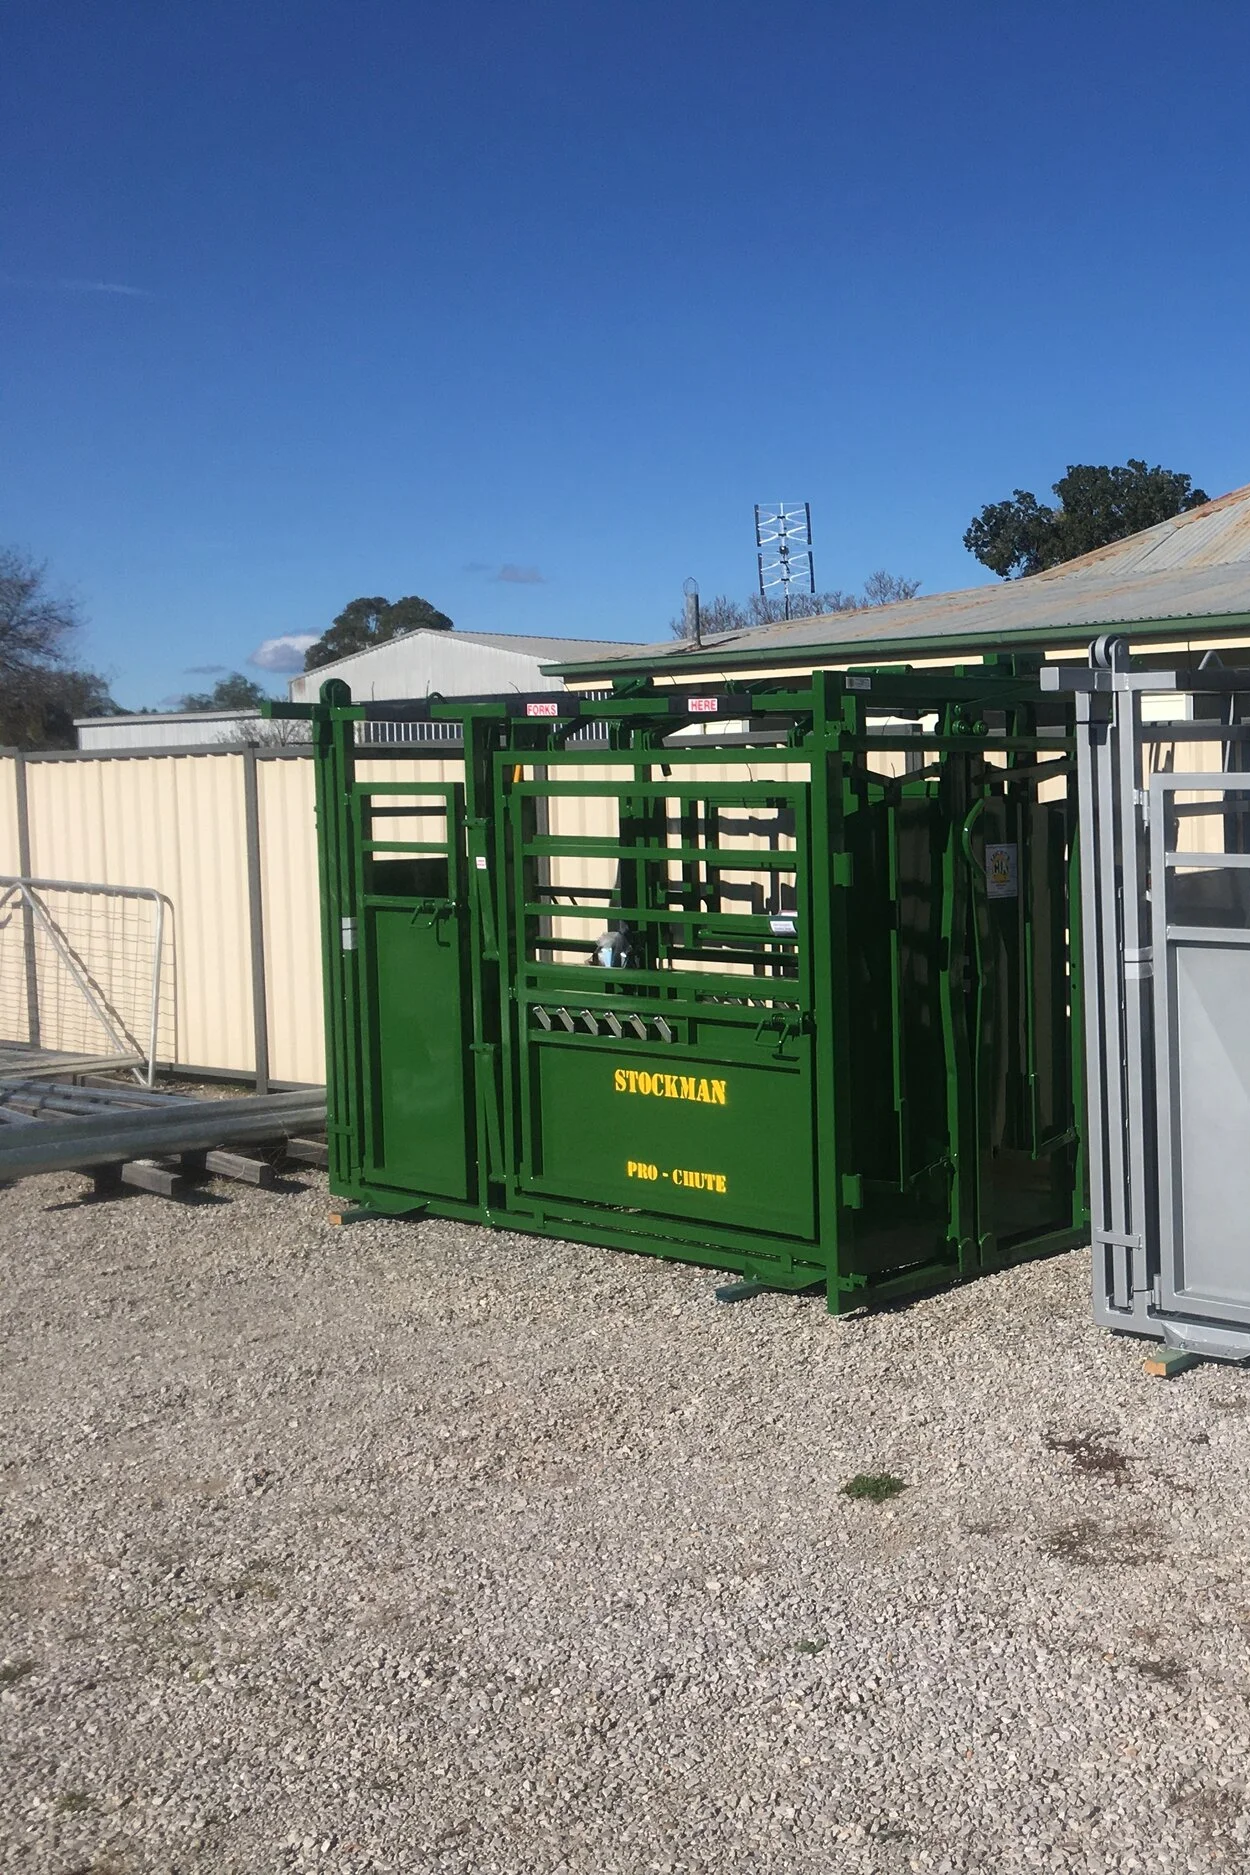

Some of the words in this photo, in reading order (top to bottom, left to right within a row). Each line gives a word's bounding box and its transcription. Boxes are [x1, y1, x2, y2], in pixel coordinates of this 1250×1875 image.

[527, 704, 557, 715] FORKS
[691, 700, 716, 711] HERE
[614, 1068, 726, 1105] STOCKMAN
[627, 1160, 658, 1181] PRO
[672, 1168, 726, 1193] CHUTE
